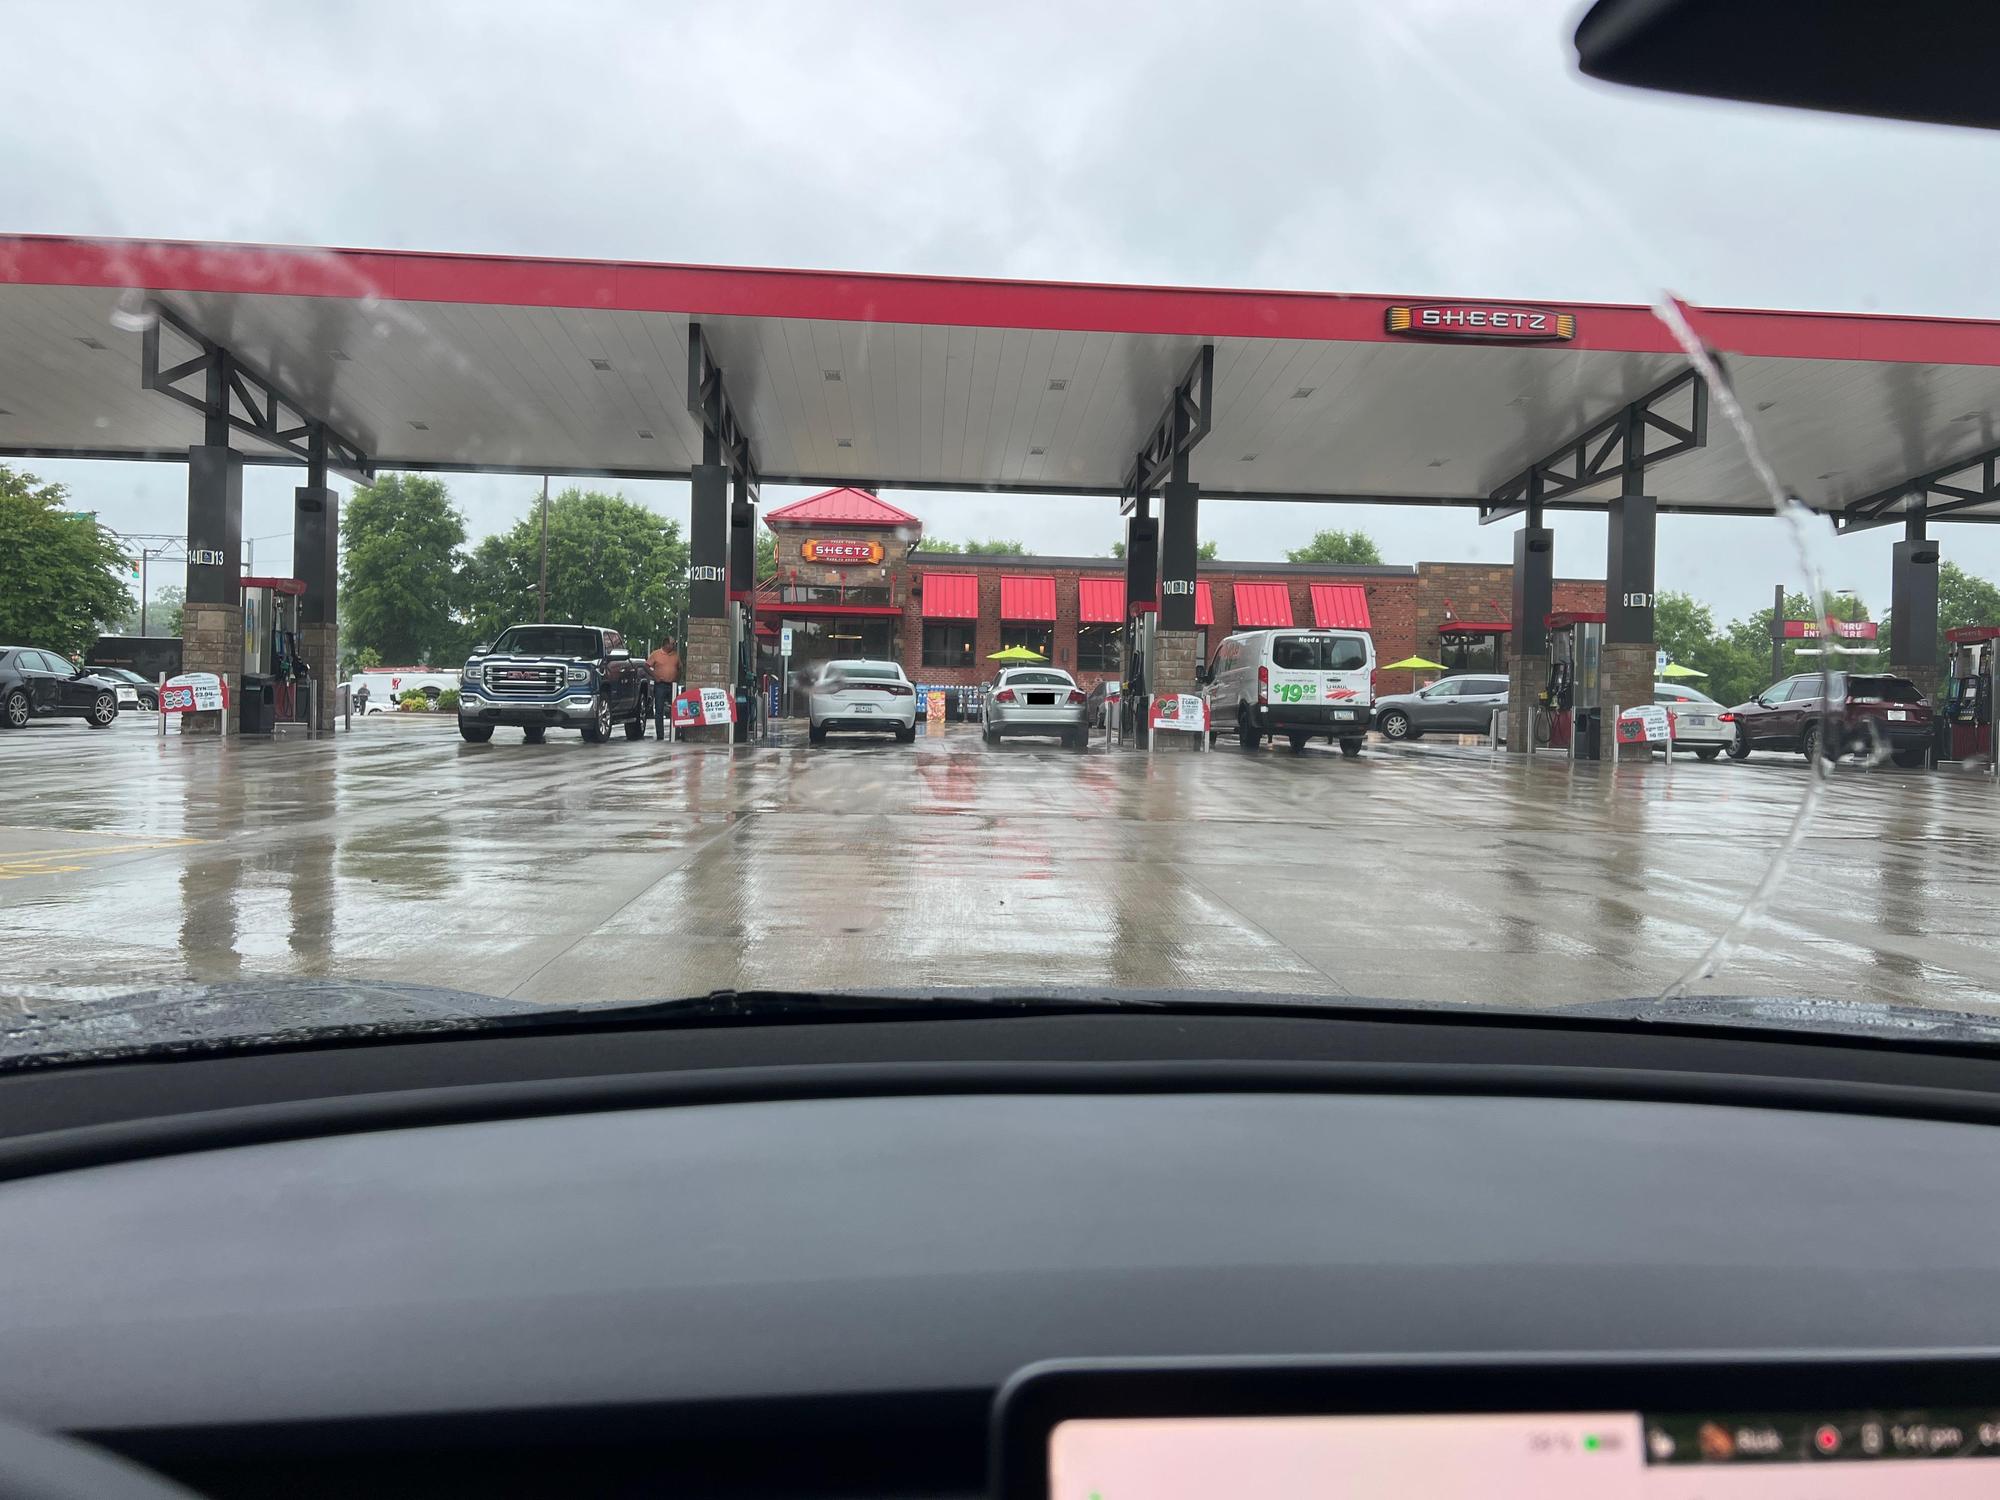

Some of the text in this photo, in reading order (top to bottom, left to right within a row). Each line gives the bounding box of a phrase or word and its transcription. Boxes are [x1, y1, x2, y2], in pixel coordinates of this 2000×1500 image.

[1422, 310, 1546, 329] SHEETZ
[188, 550, 224, 565] 14 13
[816, 546, 870, 556] SHEETZ
[691, 566, 725, 581] 12 11
[1163, 581, 1195, 595] 10 9
[1623, 593, 1653, 608] 8 7
[507, 671, 539, 680] GMC
